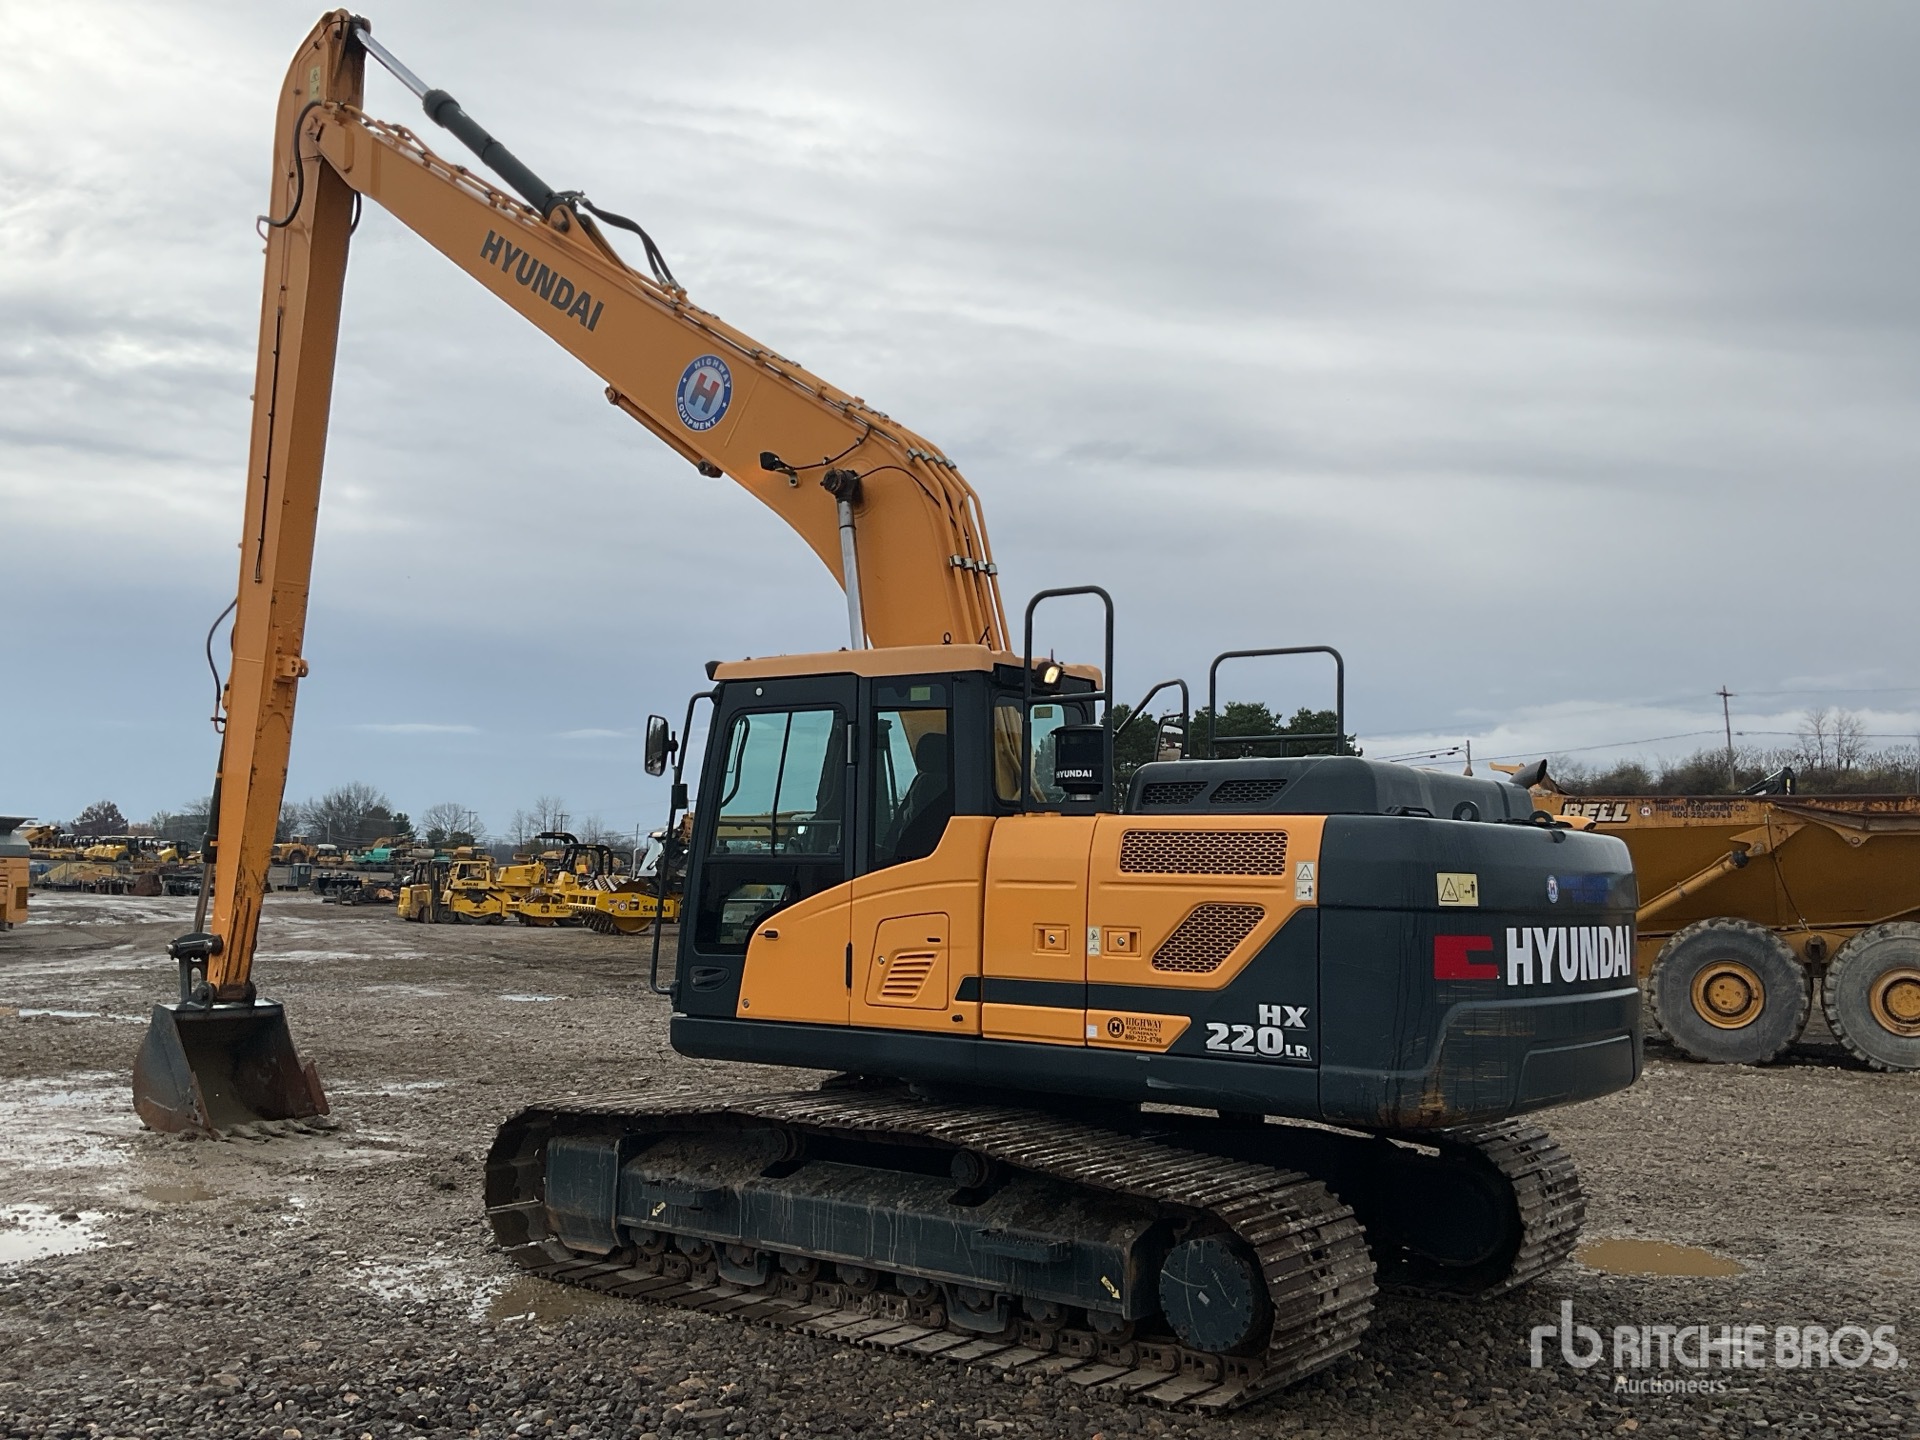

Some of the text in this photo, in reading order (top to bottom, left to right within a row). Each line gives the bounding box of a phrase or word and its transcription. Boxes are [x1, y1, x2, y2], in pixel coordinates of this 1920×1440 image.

[480, 230, 604, 332] HYUNDAI
[694, 358, 731, 388] HIGHWAY
[688, 372, 720, 414] H
[678, 396, 716, 430] EQUIPMENT
[1056, 770, 1092, 778] HYUNDAI
[1562, 802, 1630, 823] BELL
[1506, 925, 1631, 986] HYUNDAI
[1125, 1017, 1163, 1029] HIGHWAY
[1126, 1025, 1161, 1033] EQUIPMENT
[1258, 1004, 1308, 1028] HX
[1205, 1022, 1308, 1057] 220 LR
